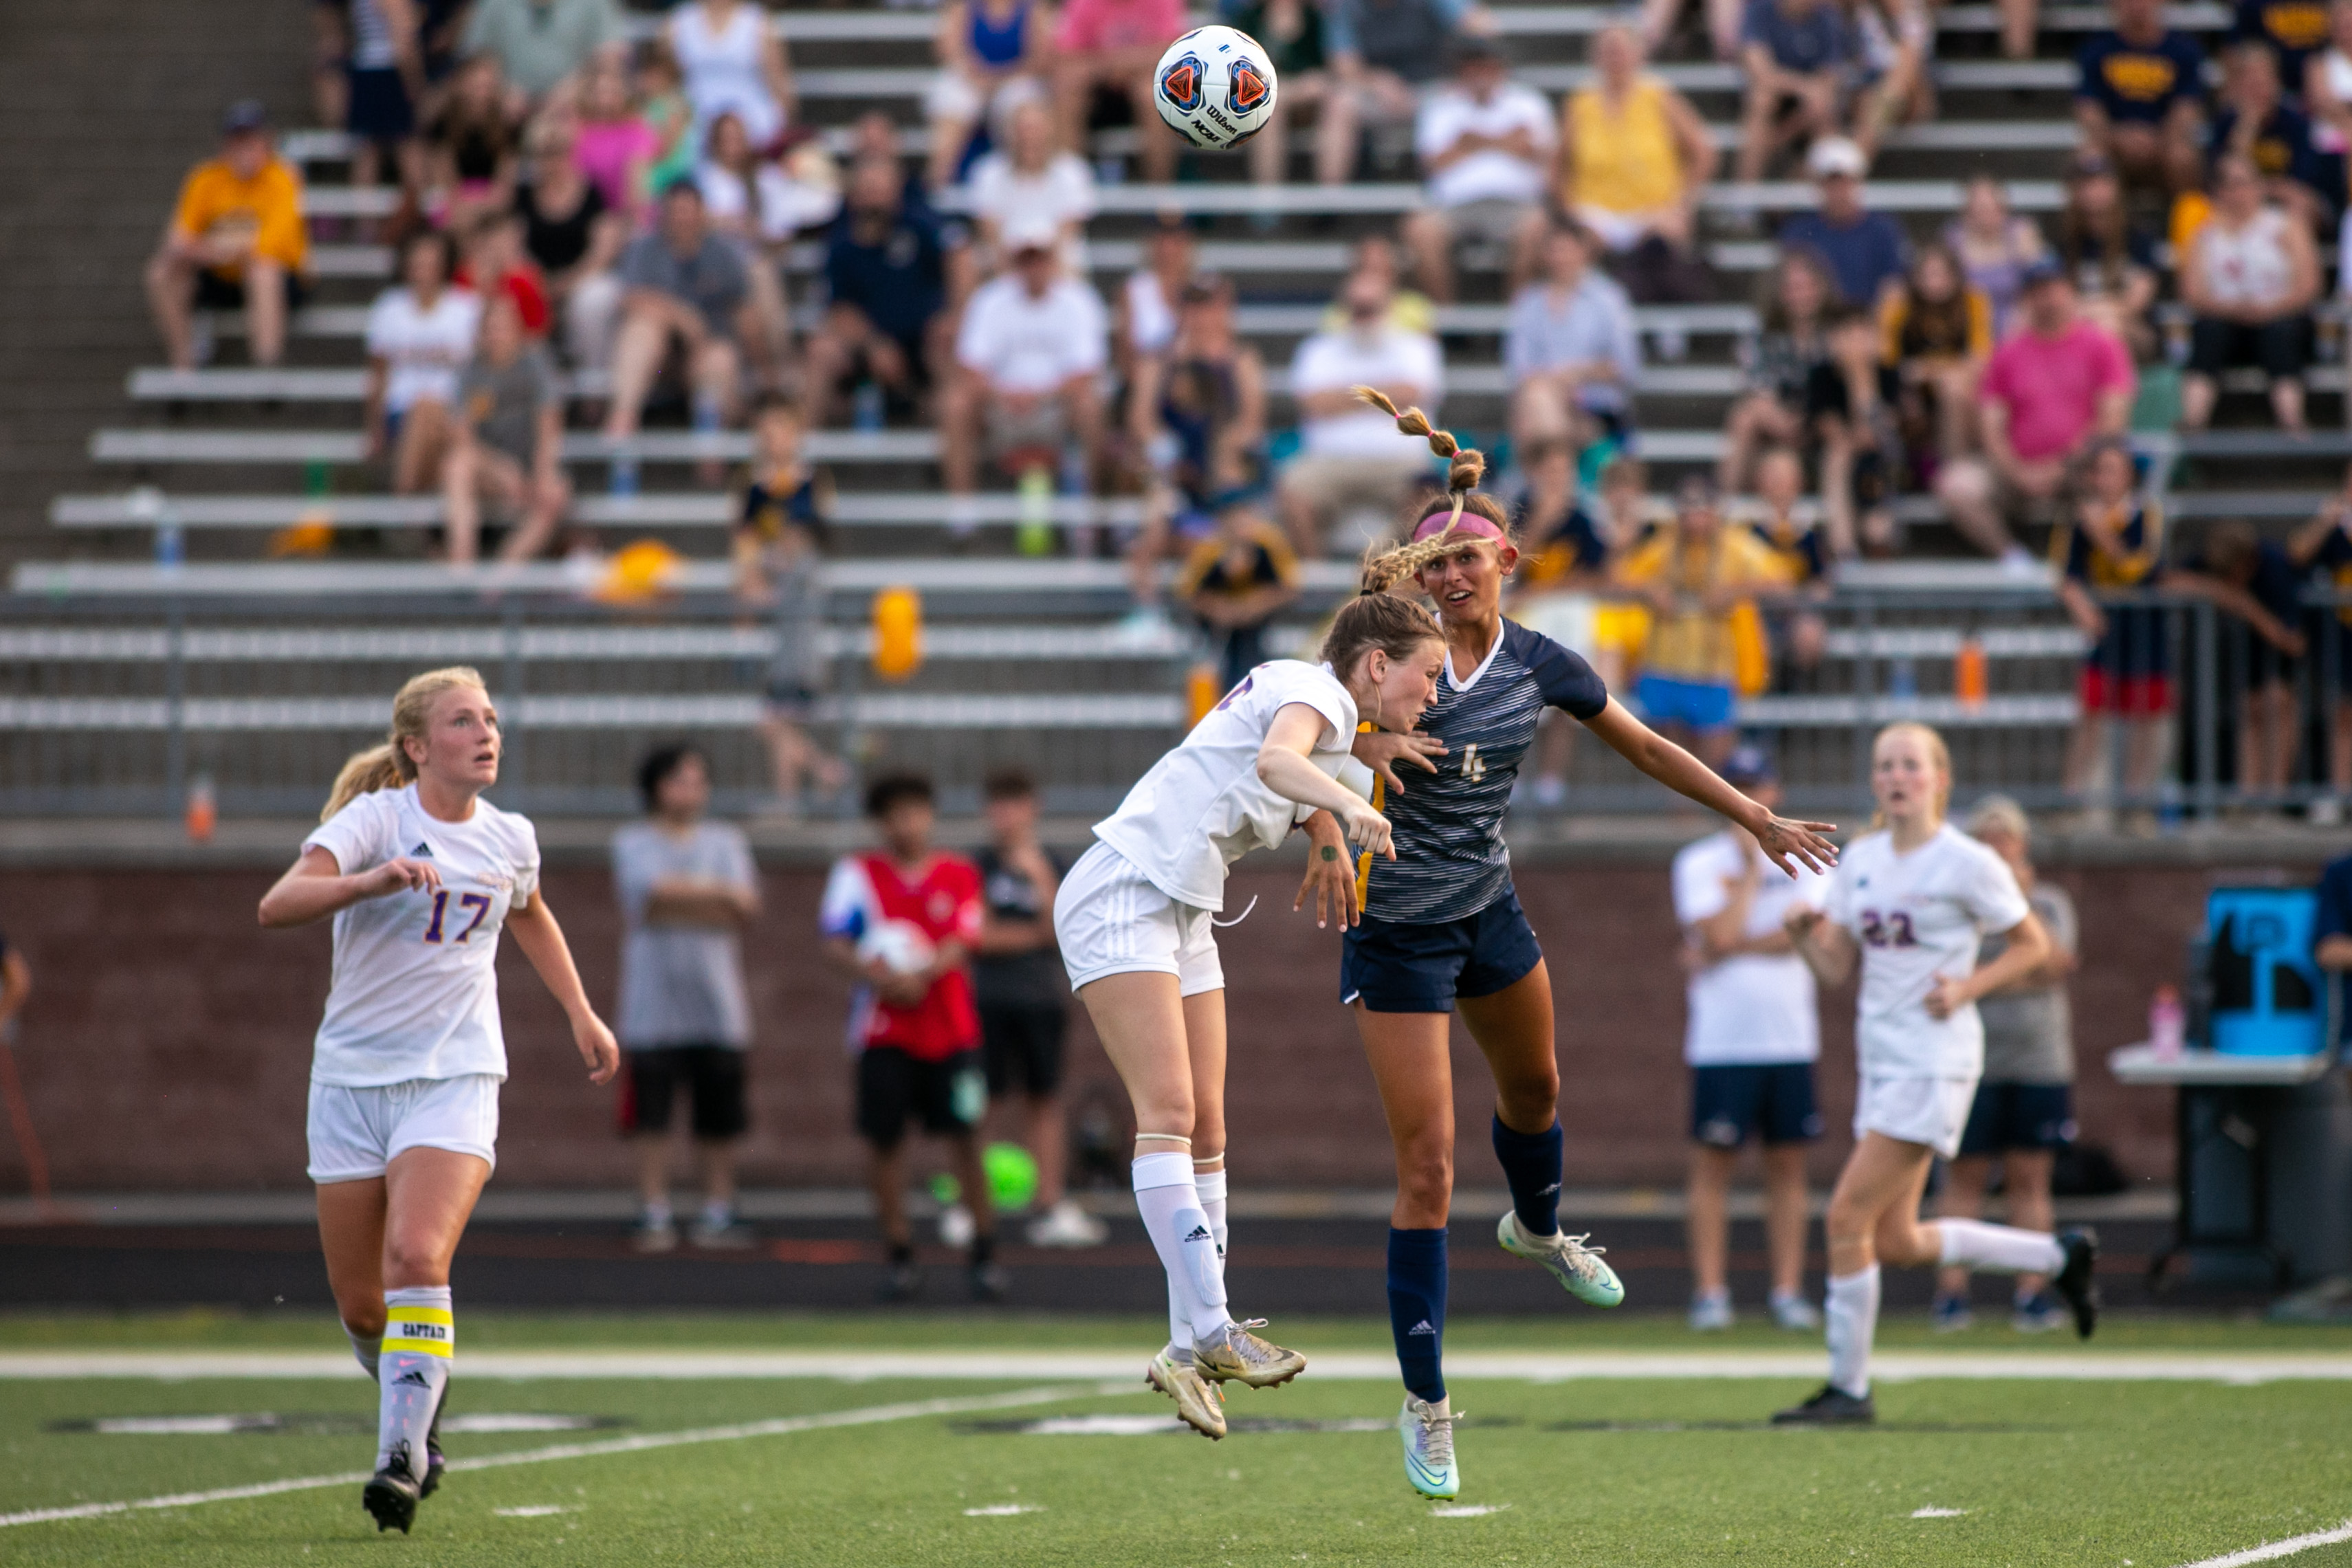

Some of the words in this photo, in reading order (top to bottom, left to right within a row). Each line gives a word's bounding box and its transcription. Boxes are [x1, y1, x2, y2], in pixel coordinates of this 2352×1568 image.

[1191, 120, 1221, 142] NCAA
[1207, 104, 1238, 135] Wilson
[1460, 743, 1486, 782] 4
[424, 890, 492, 945] 17
[1860, 909, 1918, 948] 22
[404, 1323, 446, 1338] CAPTAIN
